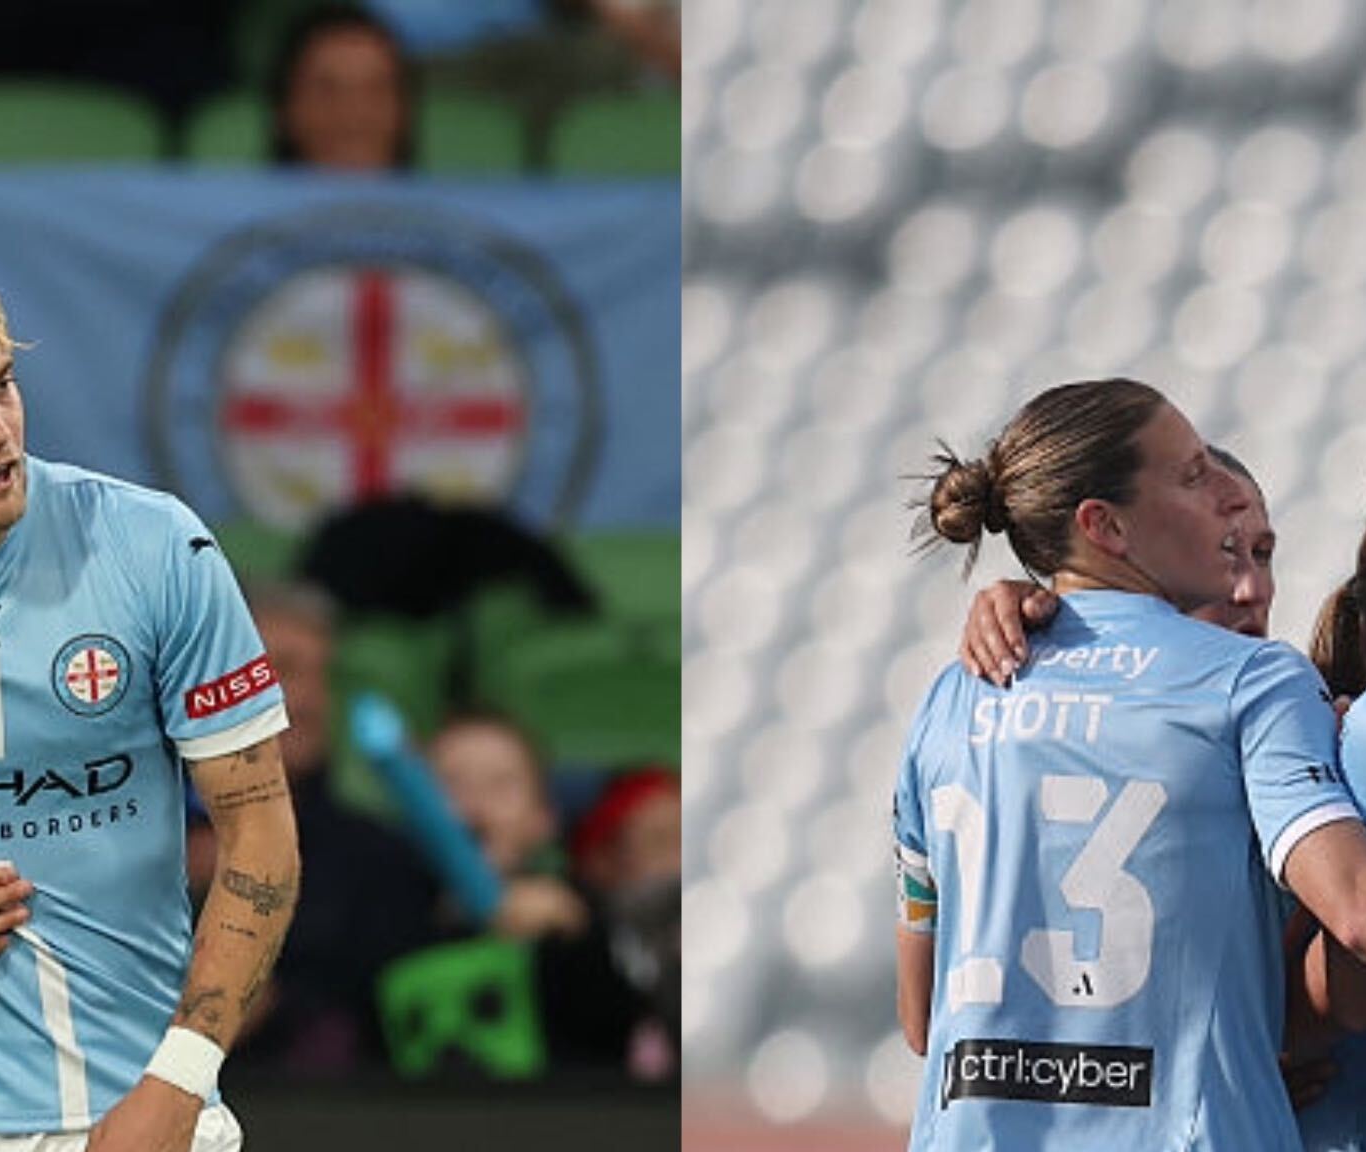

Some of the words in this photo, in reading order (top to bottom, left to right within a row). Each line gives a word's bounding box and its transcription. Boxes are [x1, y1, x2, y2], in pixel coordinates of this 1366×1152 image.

[193, 661, 271, 712] NISS
[0, 799, 138, 840] BORDERS
[931, 775, 1169, 1012] 13
[960, 1047, 1146, 1095] ctrl:cyber
